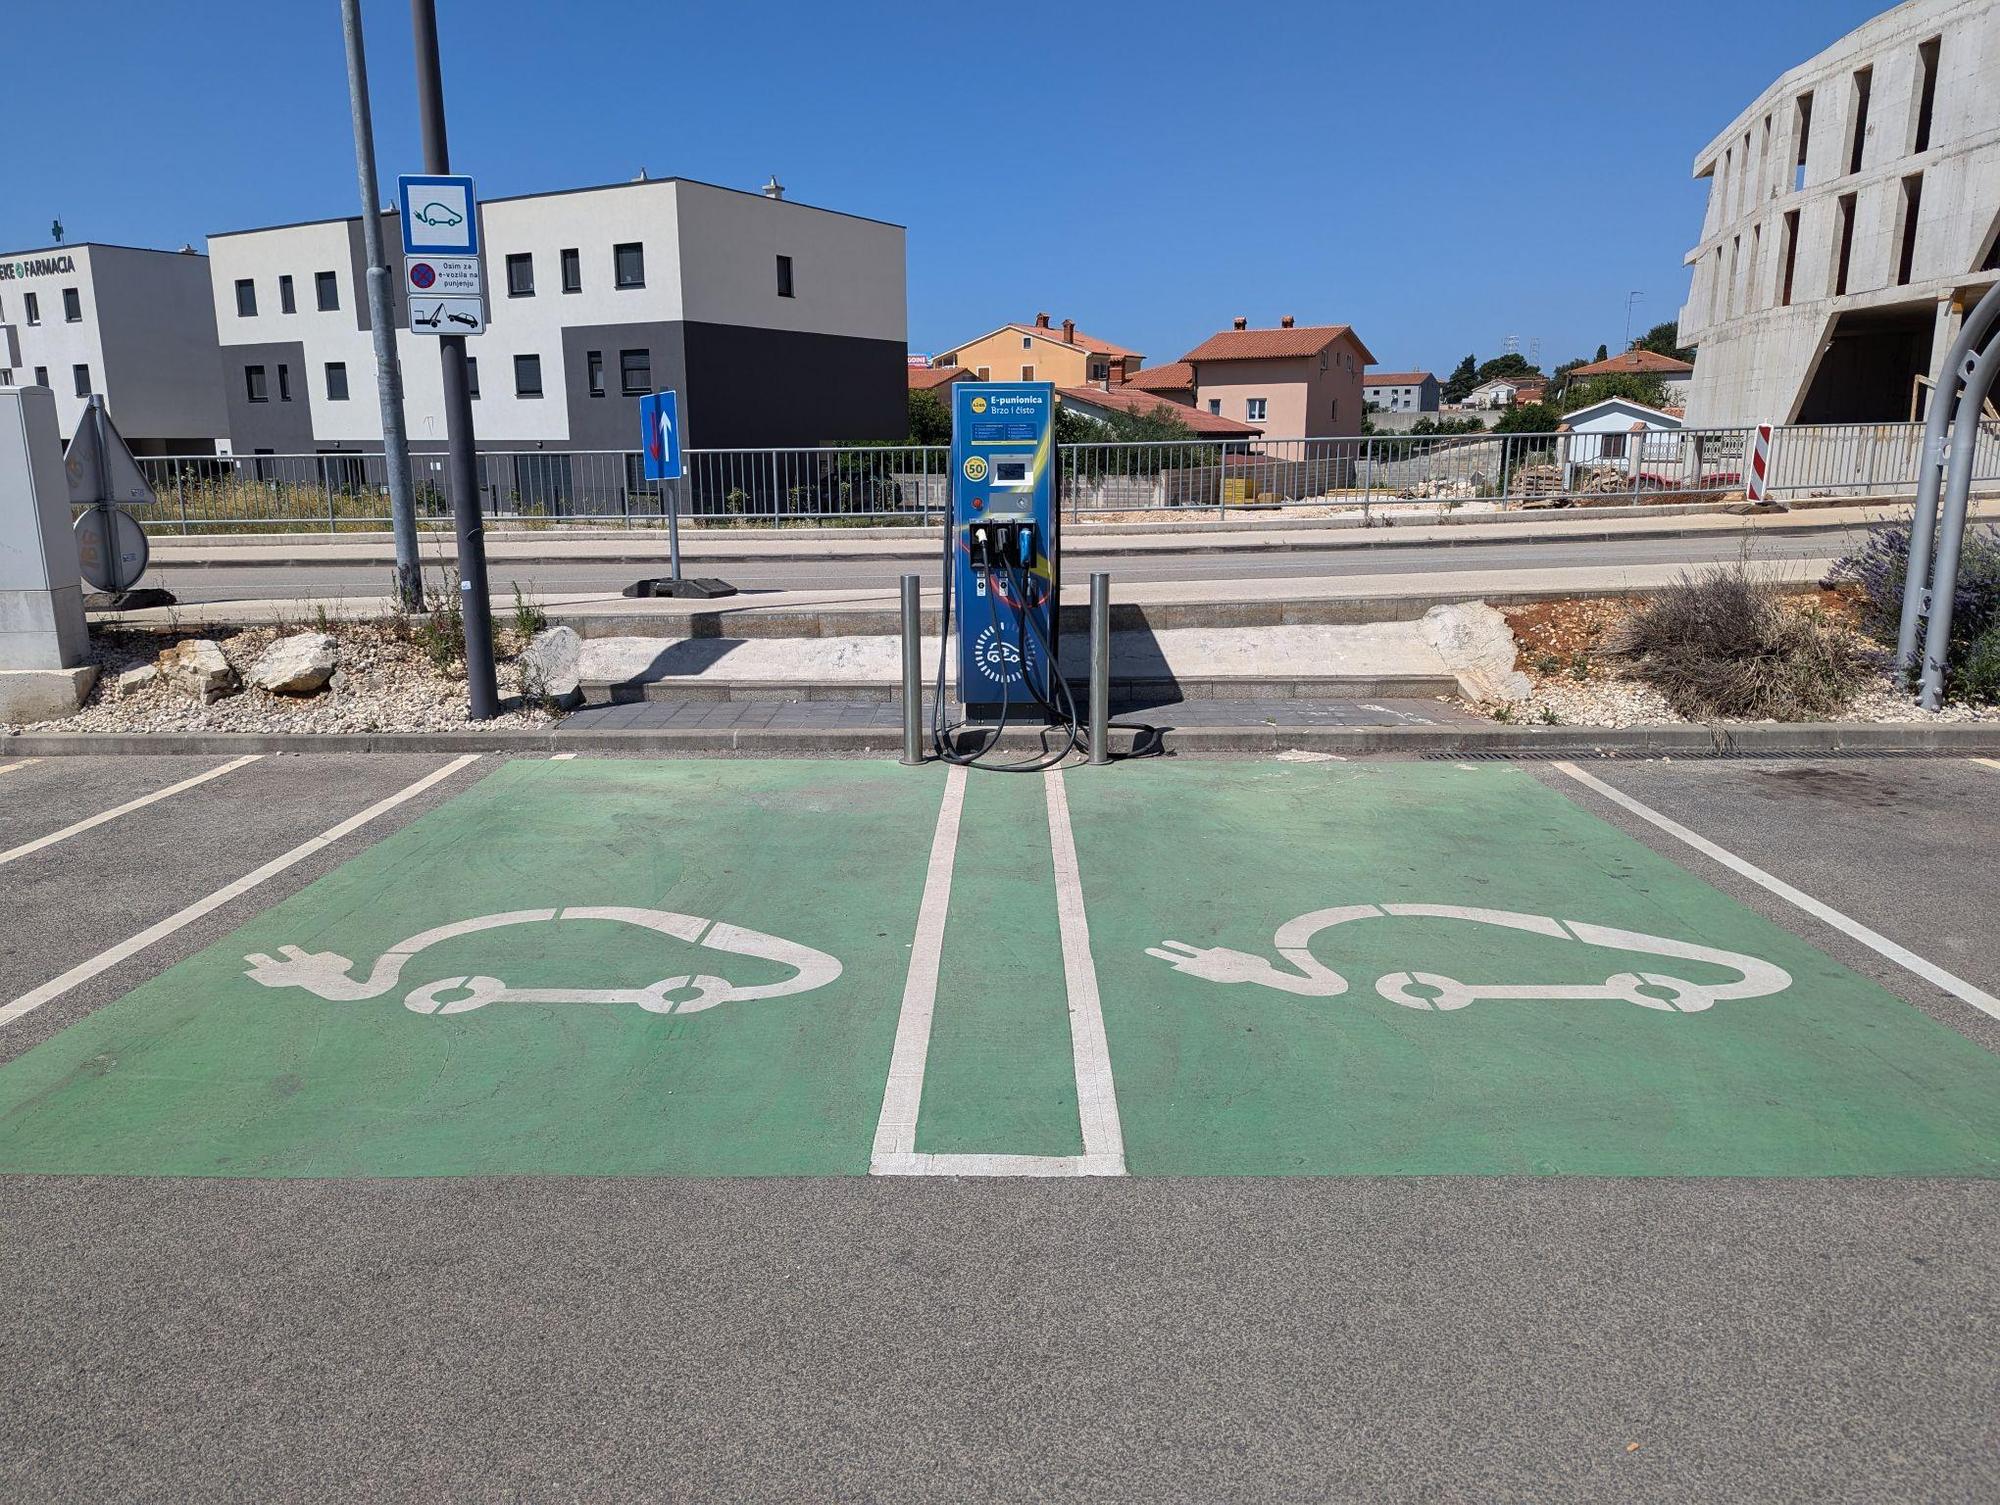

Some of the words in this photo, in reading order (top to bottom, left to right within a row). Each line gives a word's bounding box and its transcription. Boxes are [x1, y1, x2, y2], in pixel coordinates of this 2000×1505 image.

[24, 256, 76, 278] FARMACIA
[991, 396, 1042, 405] E-punionica
[991, 406, 1009, 414] Brzo
[1015, 406, 1035, 414] čisto
[969, 464, 983, 474] 50
